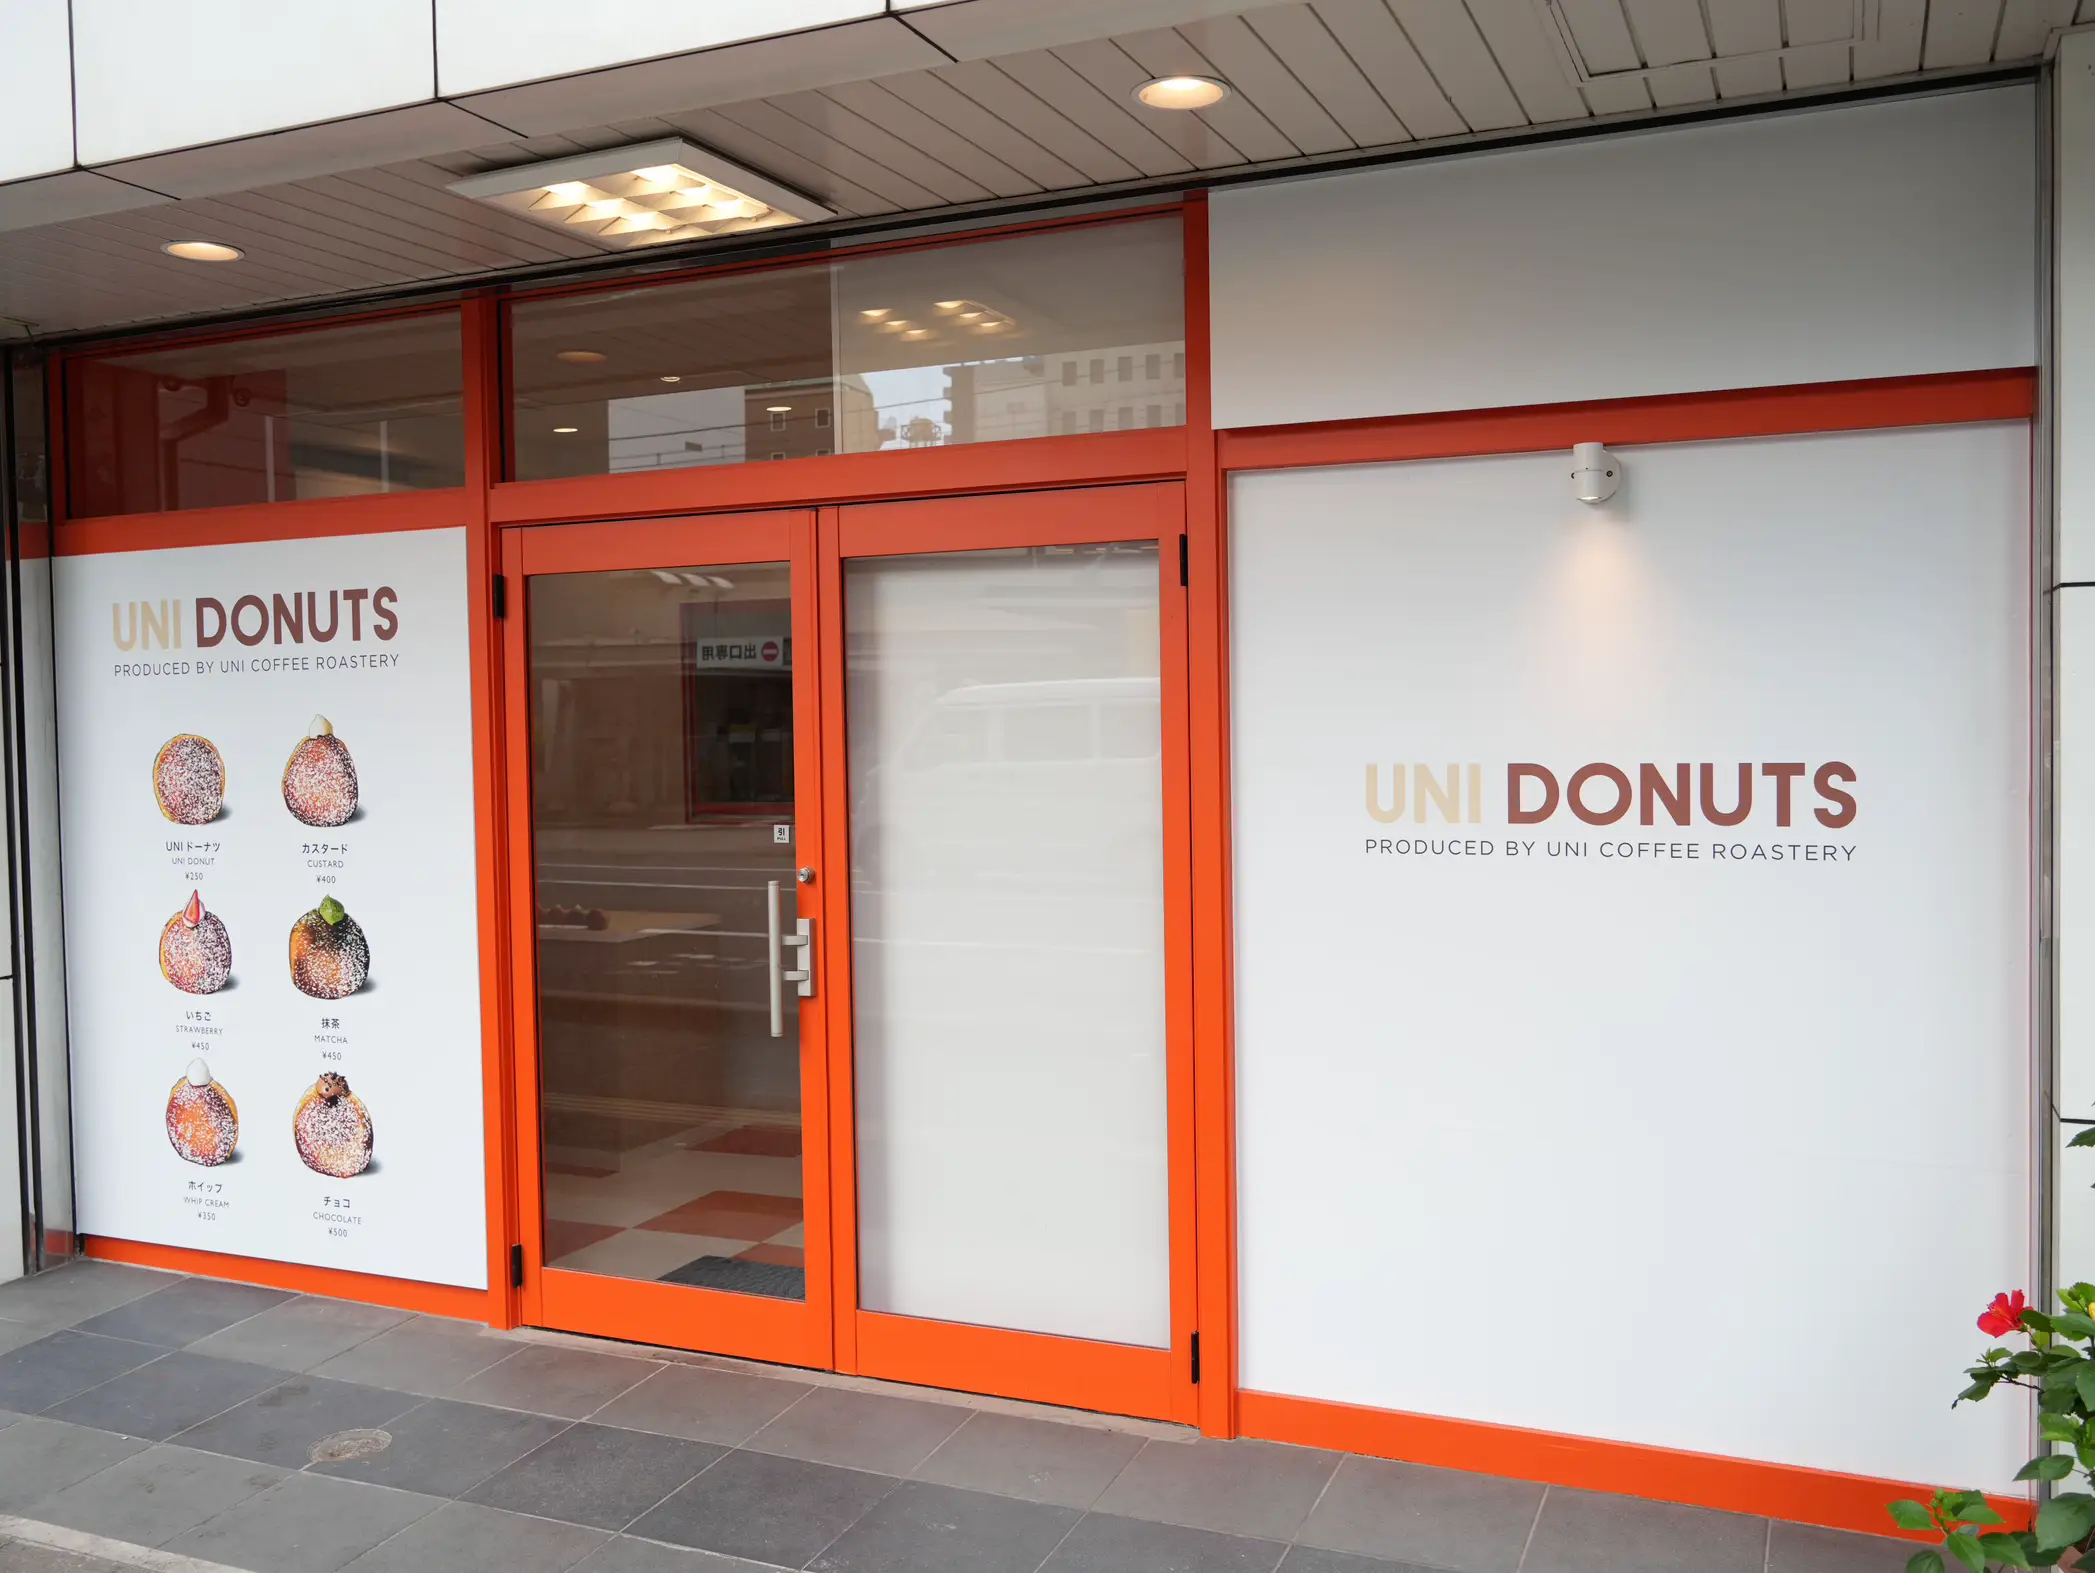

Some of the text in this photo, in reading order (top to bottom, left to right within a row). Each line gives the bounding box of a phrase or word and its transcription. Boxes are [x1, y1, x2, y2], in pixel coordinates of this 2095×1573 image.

[113, 585, 399, 651] UNI DONUTS
[114, 653, 400, 677] PRODUCED BY UNI COFFEE ROASTERY
[1365, 760, 1858, 829] UNI DONUTS
[165, 841, 221, 853] UNI ドーナツ
[301, 842, 349, 855] カスタード
[1365, 838, 1857, 862] PRODUCED BY UNI COFFEE ROASTERY
[171, 857, 216, 866] UNI DONUT
[306, 859, 345, 869] CUSTARD
[184, 871, 204, 881] ¥250
[316, 874, 337, 885] ¥400
[185, 1010, 212, 1022] いちご
[321, 1016, 340, 1030] 抹茶
[175, 1024, 224, 1036] STRAWBERRY
[313, 1034, 349, 1045] MATCHA
[191, 1041, 210, 1051] ¥450
[321, 1050, 342, 1061] ¥450
[187, 1180, 223, 1194] ホイップ
[183, 1196, 230, 1209] WHIP CREAM
[323, 1195, 351, 1209] チョコ
[197, 1211, 217, 1221] ¥350
[312, 1211, 362, 1225] CHOCOLATE
[328, 1227, 348, 1238] ¥500
